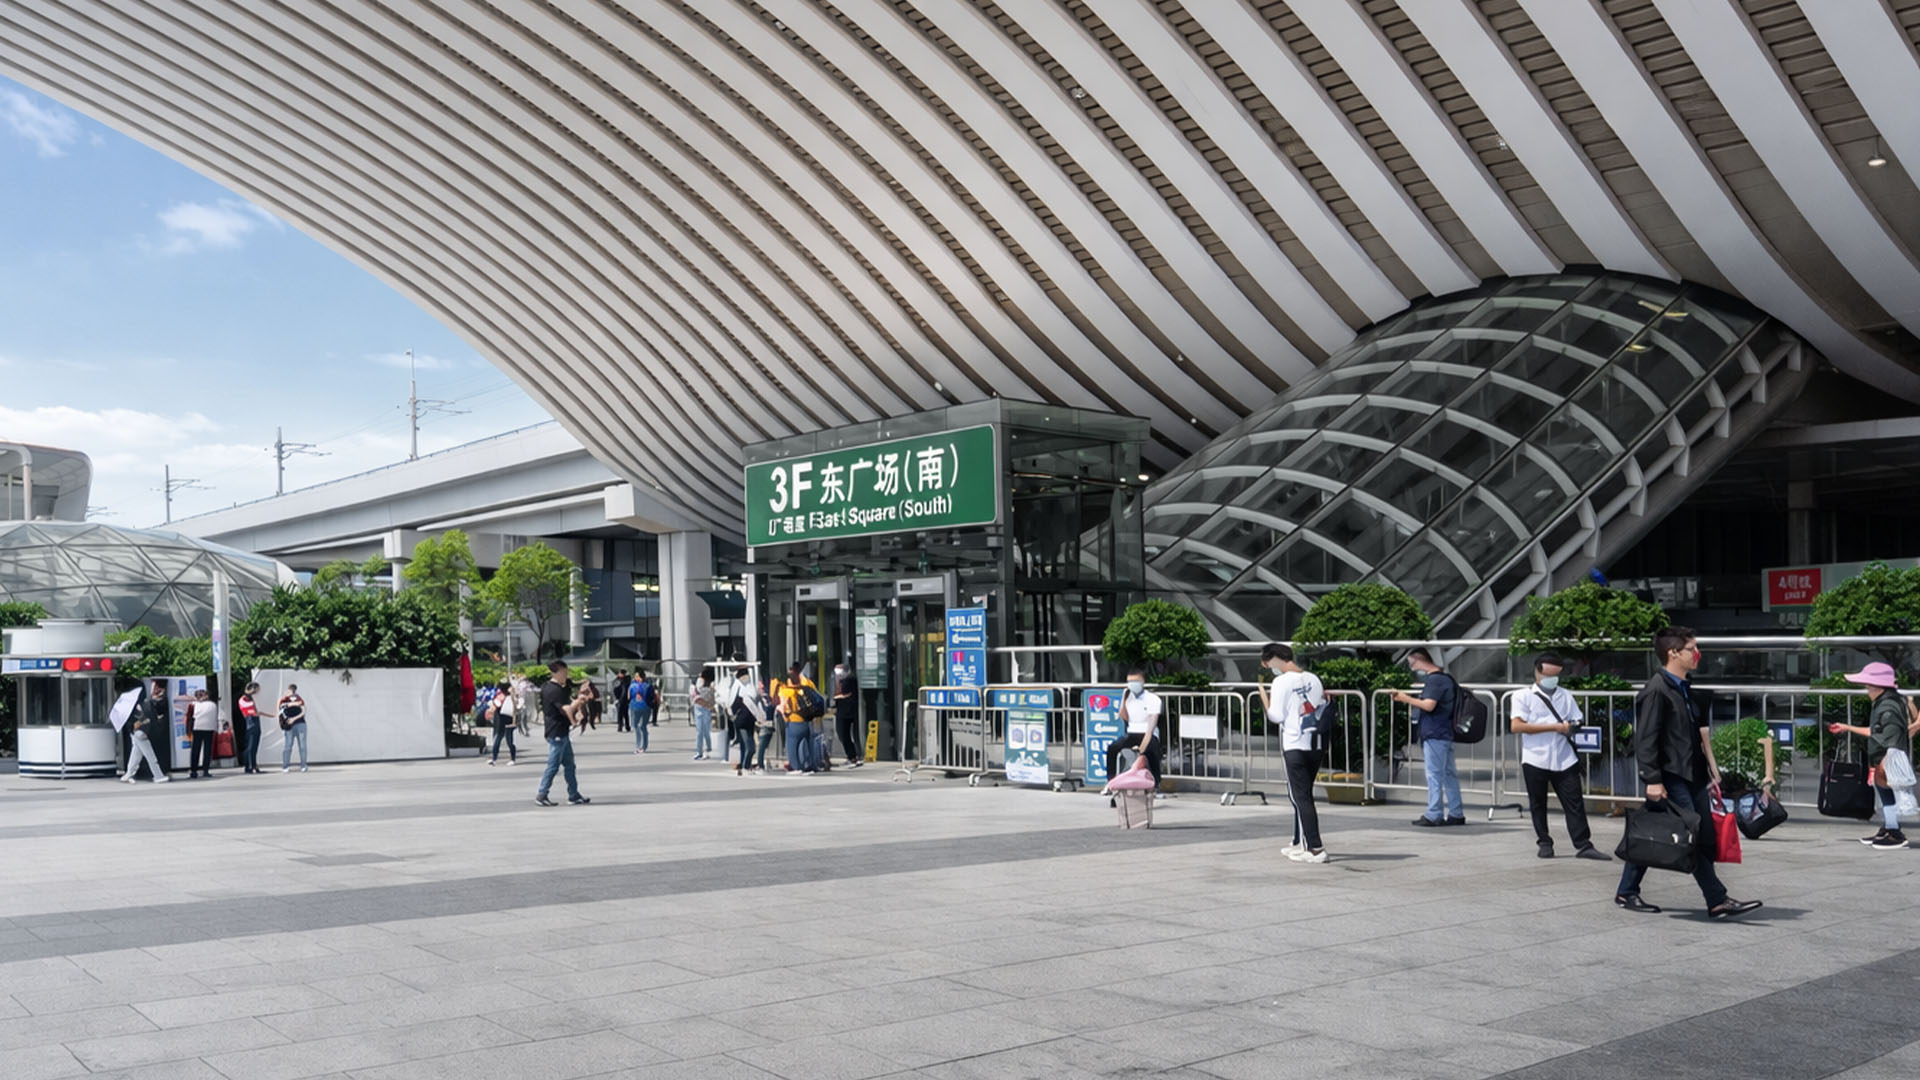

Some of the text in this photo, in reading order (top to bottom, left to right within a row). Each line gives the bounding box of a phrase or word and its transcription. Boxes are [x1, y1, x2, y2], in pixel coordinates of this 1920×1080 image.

[769, 443, 959, 513] 3F 东广场(南)
[849, 506, 896, 527] Square
[899, 493, 952, 523] (South)
